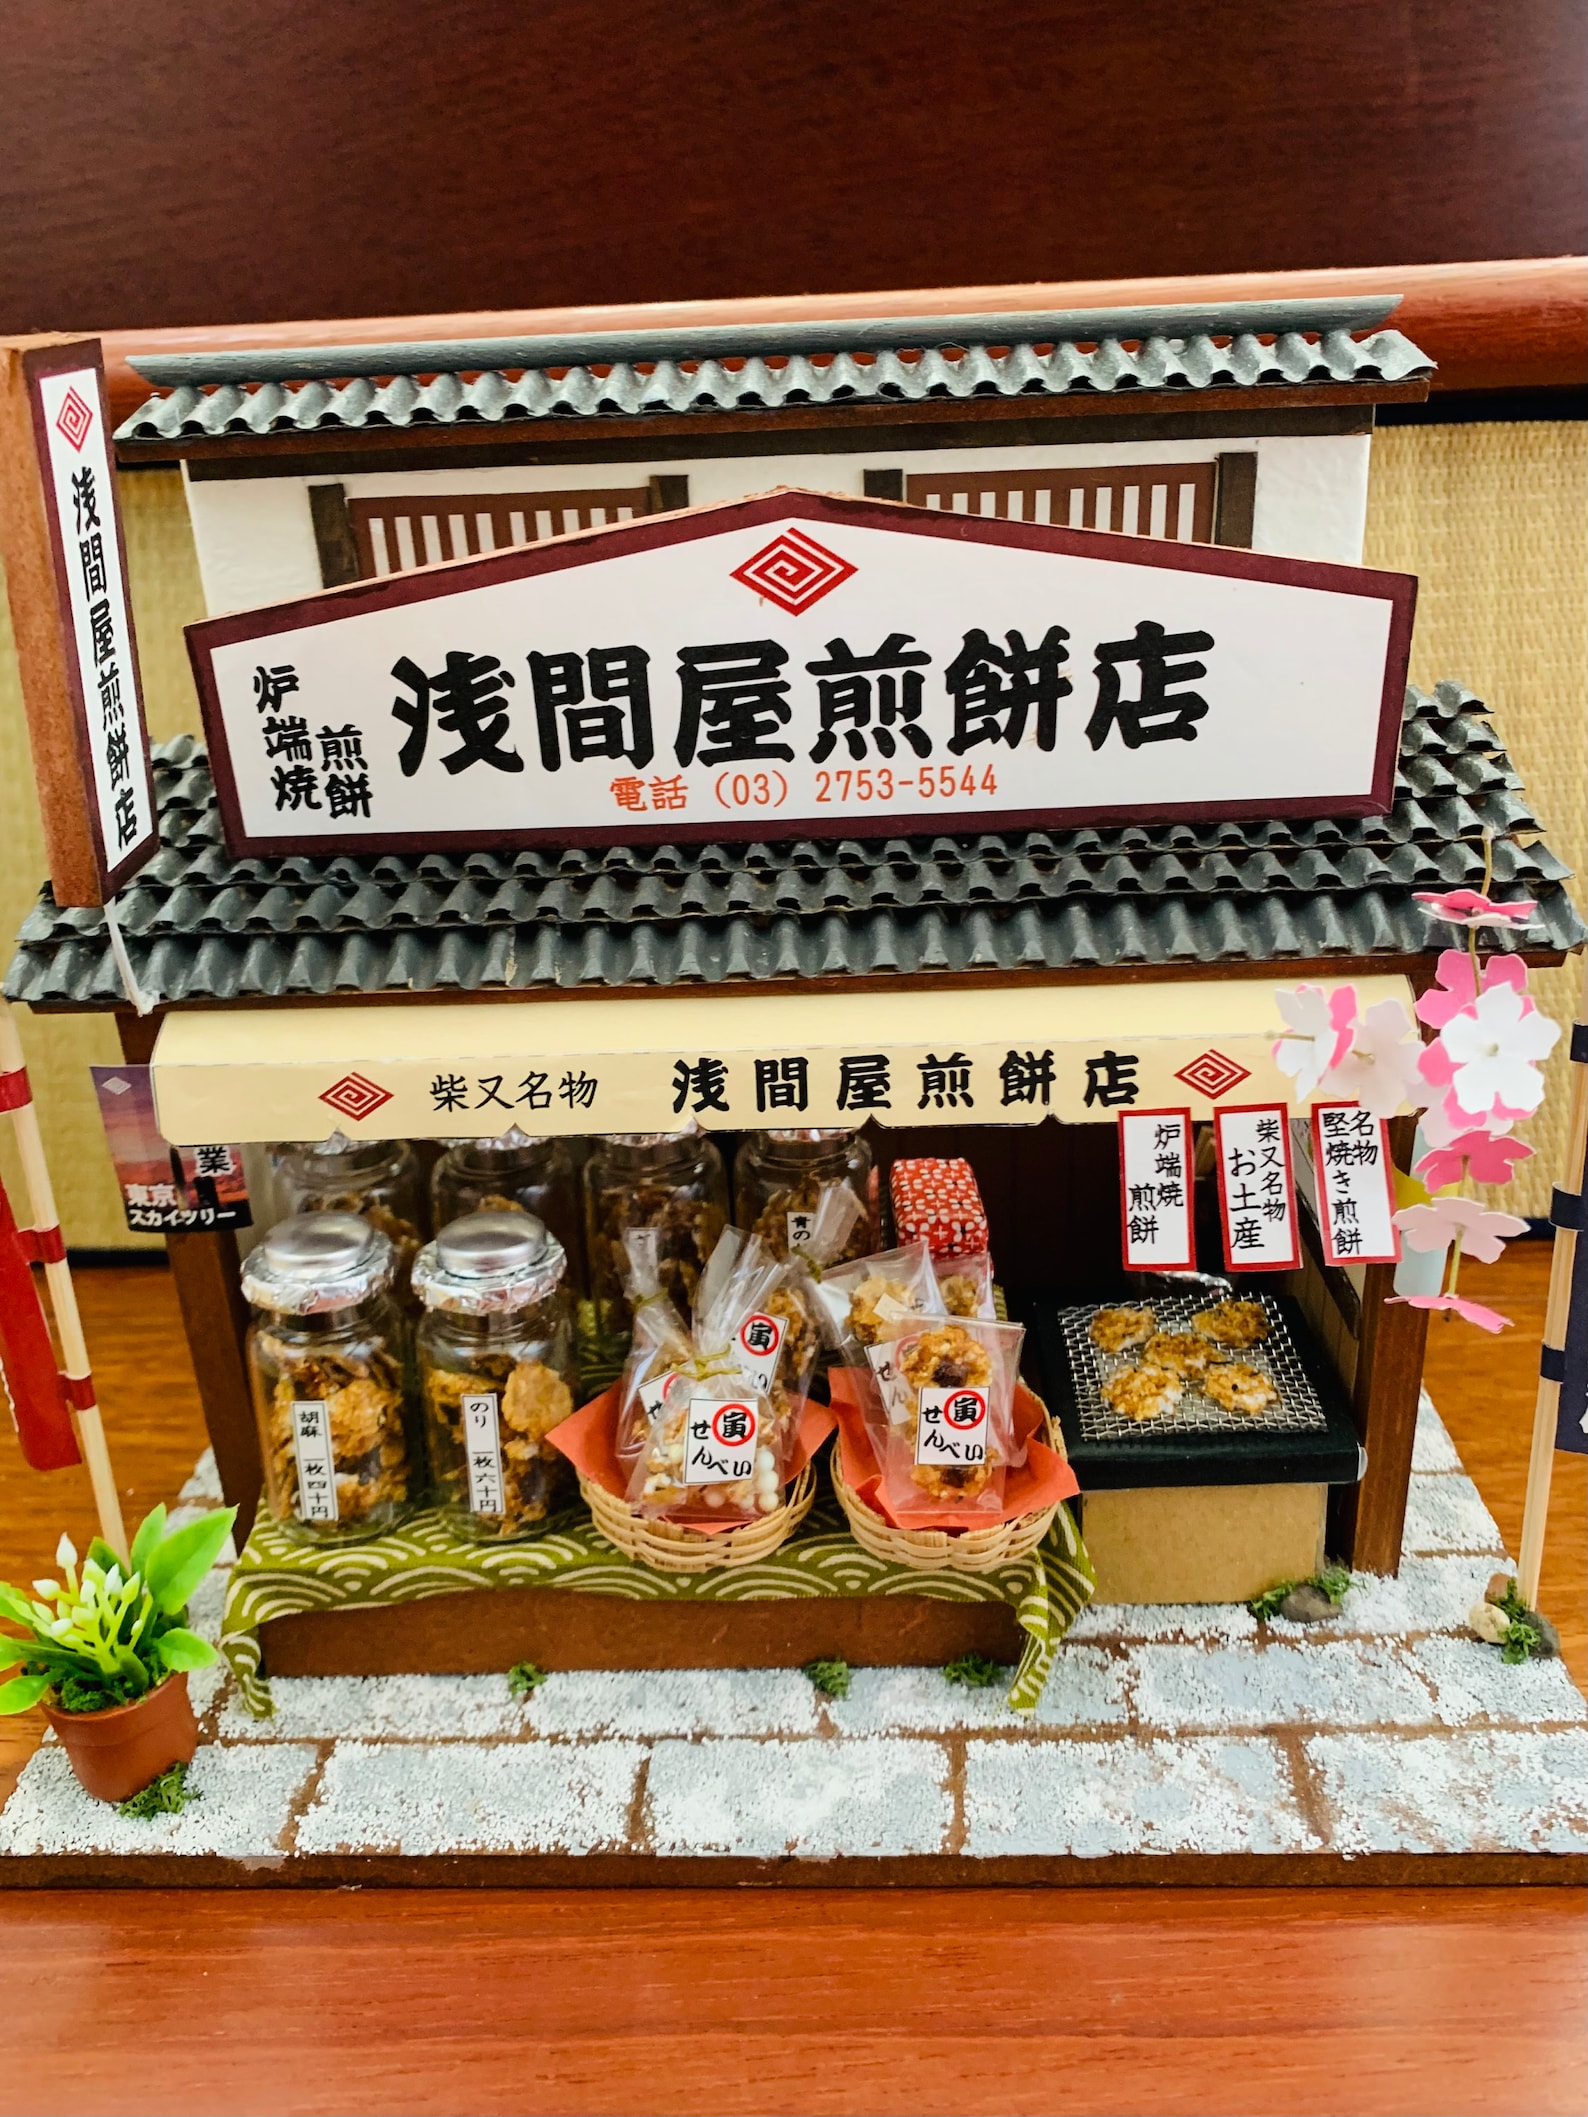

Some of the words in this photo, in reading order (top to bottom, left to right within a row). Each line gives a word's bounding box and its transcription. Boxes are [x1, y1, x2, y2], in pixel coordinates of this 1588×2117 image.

[391, 620, 1214, 777] 浅間屋煎餅店
[252, 665, 322, 812] 炉端焼
[314, 724, 373, 819] 煎餅
[609, 774, 688, 812] 電話
[815, 763, 998, 803] 2753-5544
[430, 1071, 597, 1112] 柴又名物
[1154, 1123, 1185, 1208] 炉端焼
[1350, 1110, 1379, 1167] 名物
[124, 1183, 177, 1207] 東京
[1228, 1147, 1265, 1250] お土産
[1256, 1118, 1287, 1223] 柴又名物
[1322, 1112, 1363, 1255] 堅焼き煎餅
[128, 1207, 237, 1228] スカイツリー
[1127, 1182, 1160, 1245] 煎餅
[470, 1402, 489, 1428] のり
[922, 1405, 984, 1461] せんべい
[690, 1419, 753, 1478] せんべい
